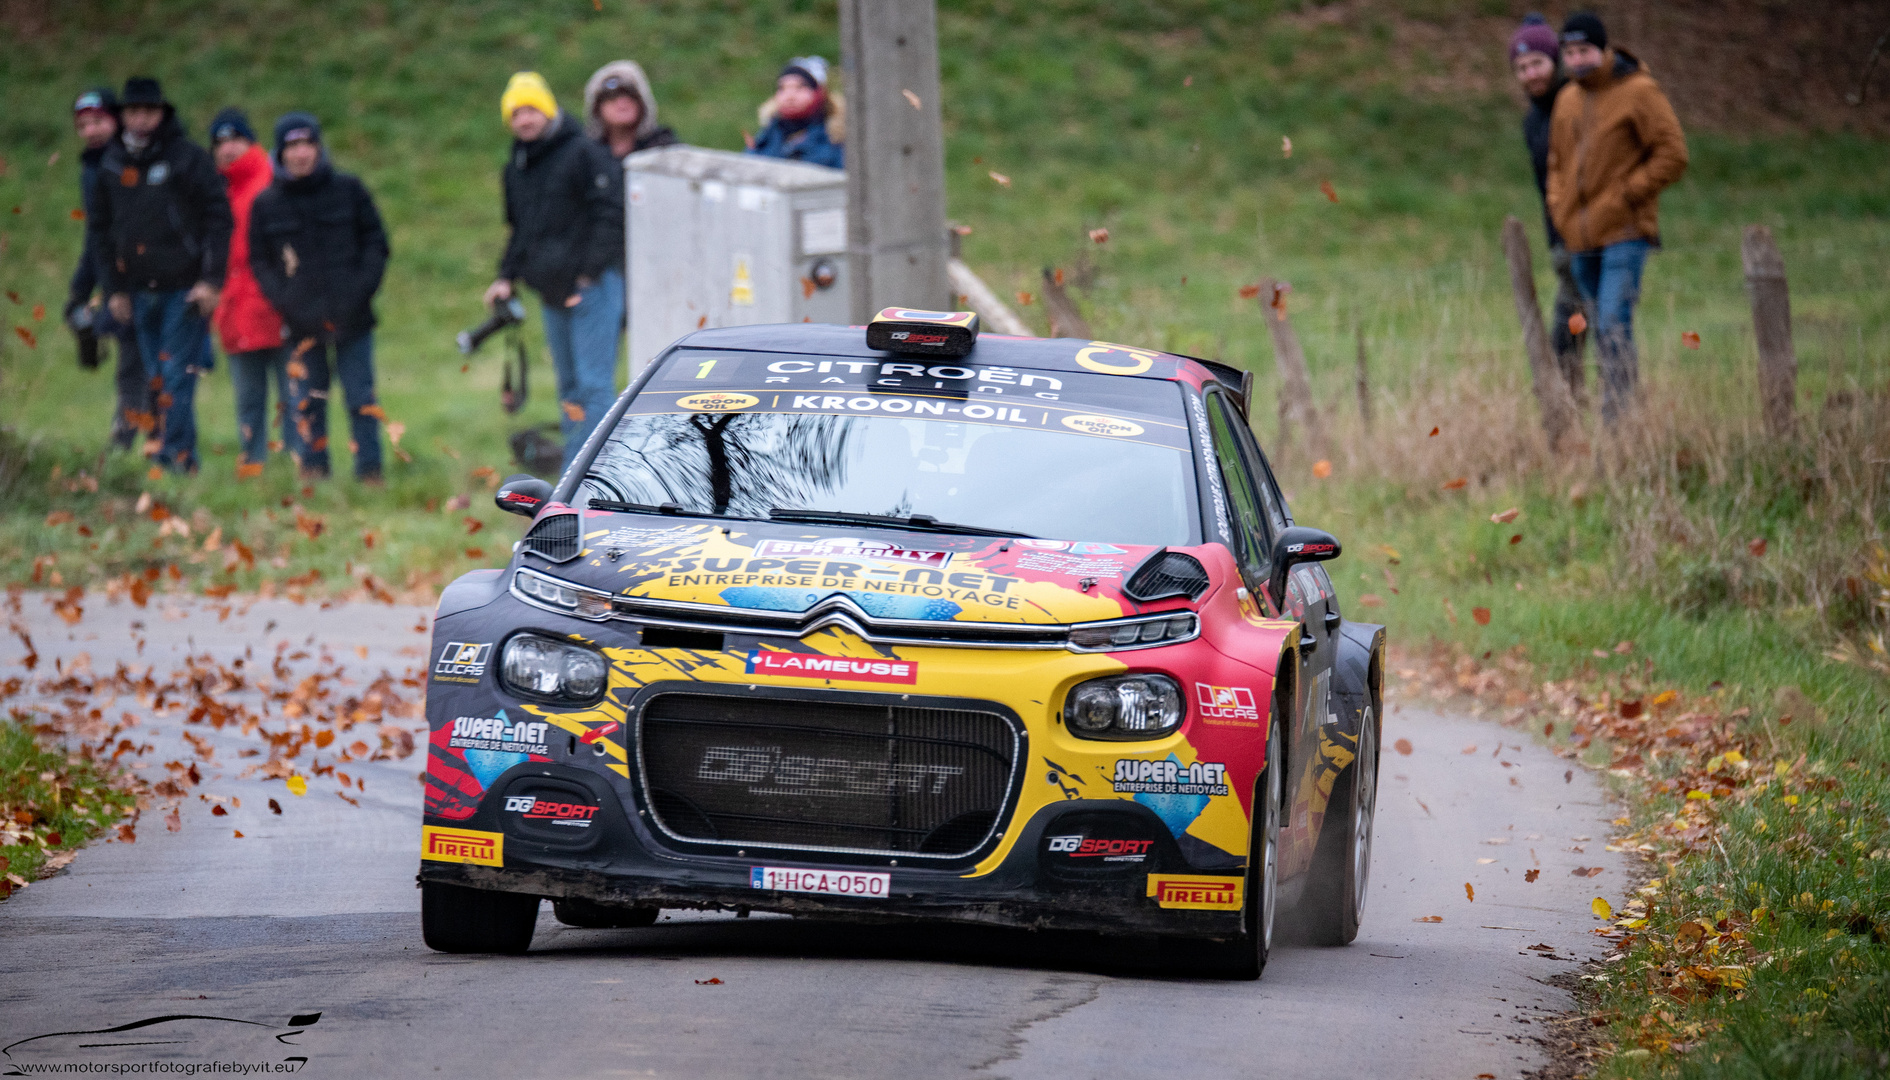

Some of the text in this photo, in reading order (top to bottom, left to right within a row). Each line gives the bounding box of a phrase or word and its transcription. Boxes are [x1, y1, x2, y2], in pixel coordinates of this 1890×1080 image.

[695, 360, 718, 378] 1
[767, 361, 1062, 390] CITROËN
[792, 395, 1027, 423] KROON-OIL
[1073, 419, 1132, 432] KROON
[1088, 427, 1113, 435] OIL
[771, 543, 833, 553] SPA
[843, 547, 936, 562] RALLY
[672, 558, 1019, 593] SUPER-NET
[668, 574, 1020, 610] ENTREPRISE DE NETTOYAGE
[434, 664, 485, 675] LUCAS
[1200, 705, 1259, 720] LUCAS
[451, 716, 548, 744] SUPER-NET
[450, 738, 548, 755] ENTREPRISE DE NETTOYAGE
[1114, 760, 1225, 785] SUPER-NET
[1114, 782, 1228, 795] ENTREPRISE DE NETTOYAGE
[429, 832, 495, 860] PIRELLI
[768, 870, 883, 895] 1-HCA-050
[1157, 881, 1235, 904] PIRELLI
